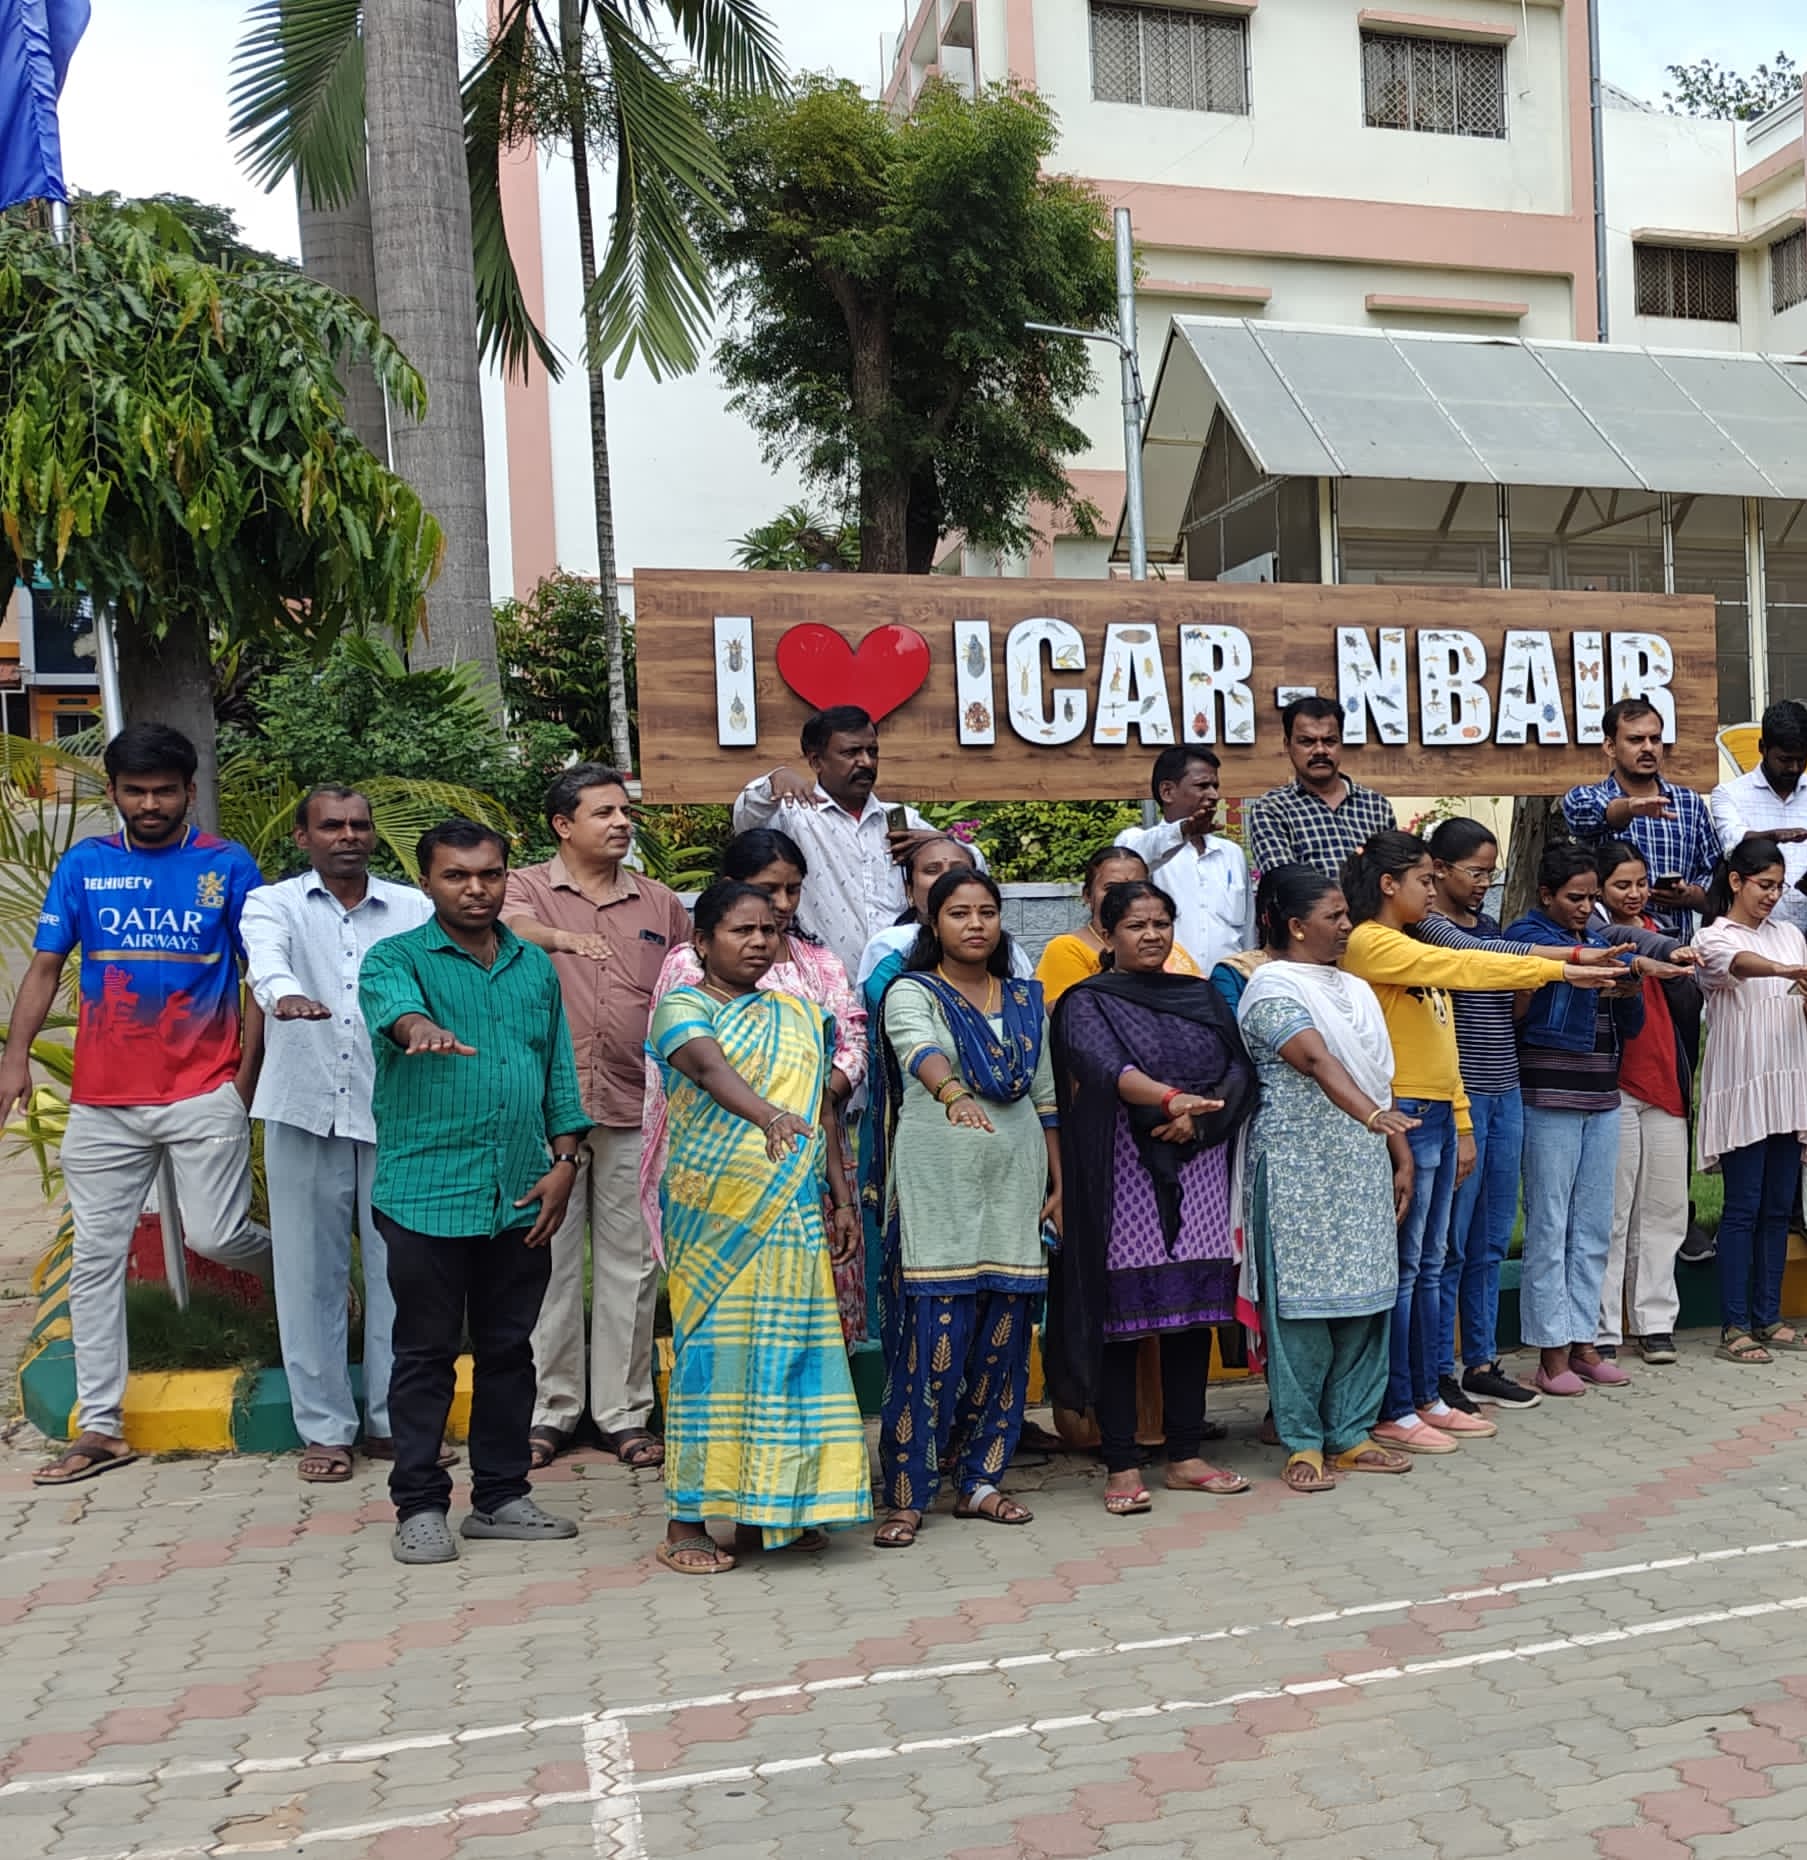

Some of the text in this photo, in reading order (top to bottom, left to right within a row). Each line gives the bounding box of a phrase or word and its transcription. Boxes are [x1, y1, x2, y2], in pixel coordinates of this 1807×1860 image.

[714, 616, 758, 747] I
[83, 876, 153, 890] DELHIVERY
[98, 906, 203, 935] QATAR
[121, 933, 200, 951] AIRWAYS
